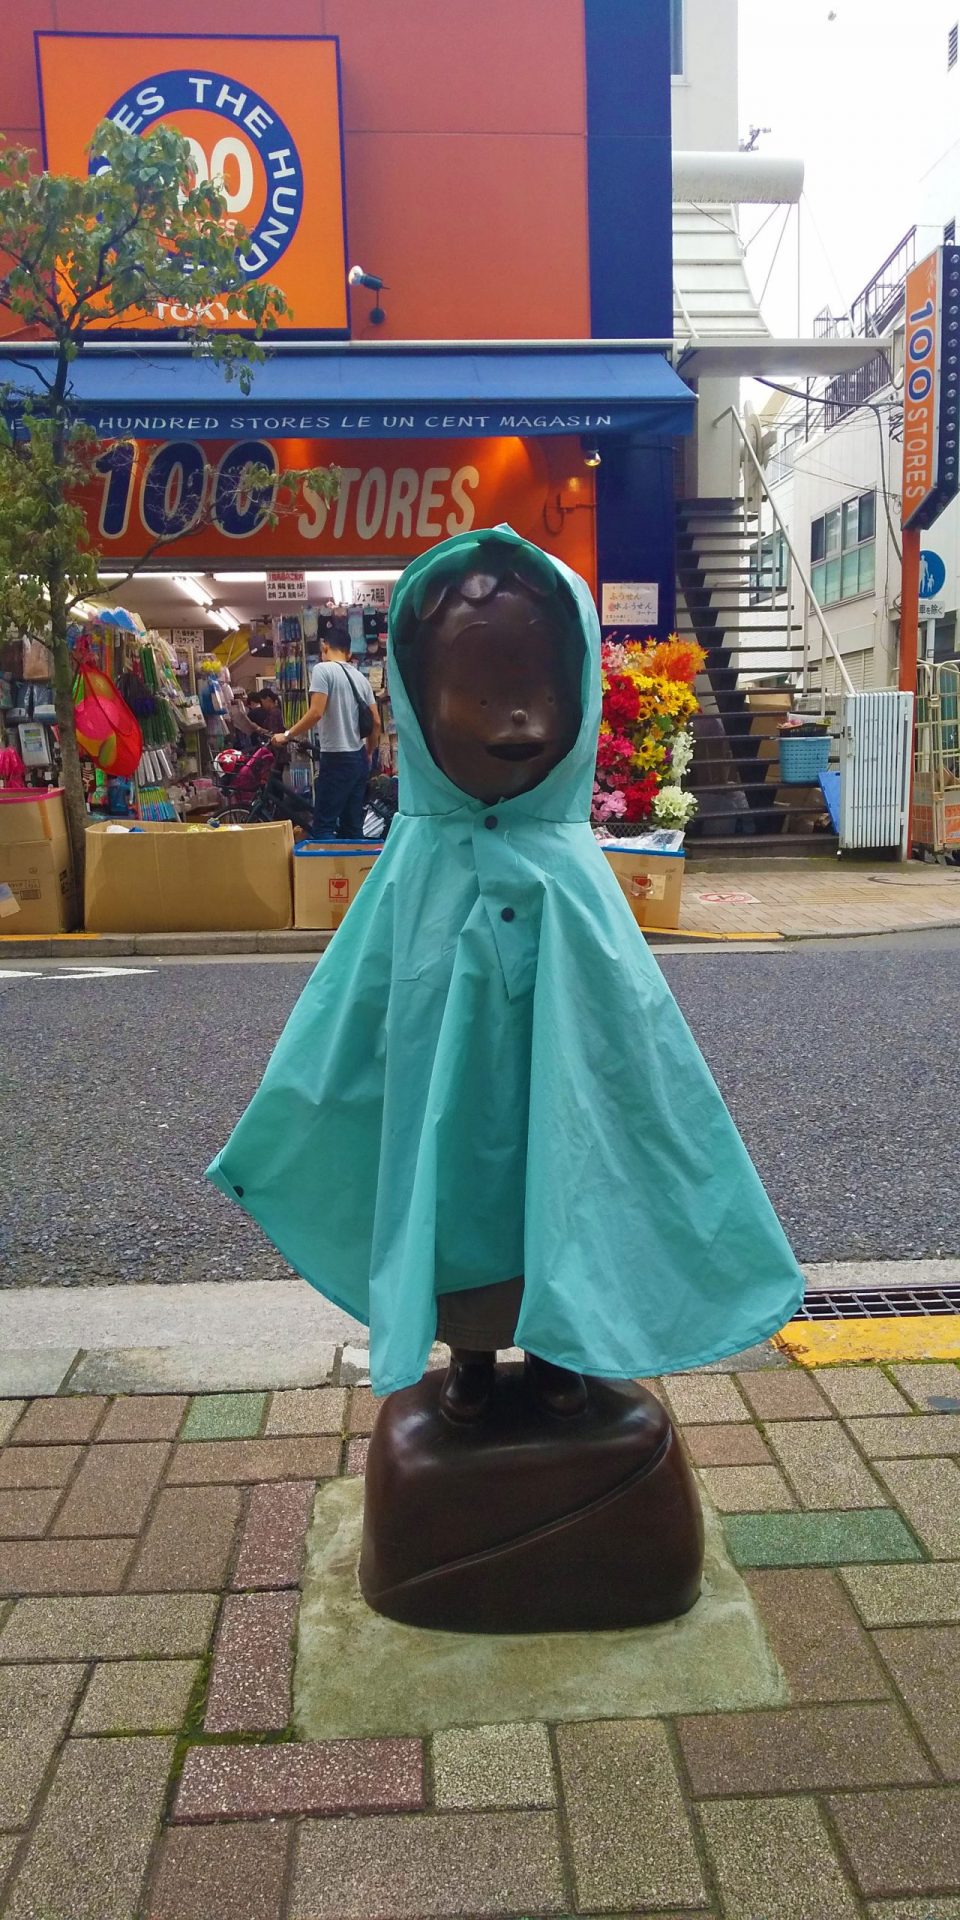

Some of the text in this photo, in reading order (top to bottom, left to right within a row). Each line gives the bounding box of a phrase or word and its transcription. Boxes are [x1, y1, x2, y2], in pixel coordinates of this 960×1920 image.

[188, 77, 274, 138] THE
[239, 148, 298, 272] HUND
[908, 297, 934, 404] 100
[98, 416, 220, 430] HUNDRED
[230, 416, 330, 430] STORES
[341, 415, 372, 429] LE
[383, 415, 415, 428] UN
[425, 415, 490, 429] CENT
[499, 414, 612, 429] MAGASIN
[905, 406, 928, 499] STORES
[95, 437, 480, 541] 100 STORES
